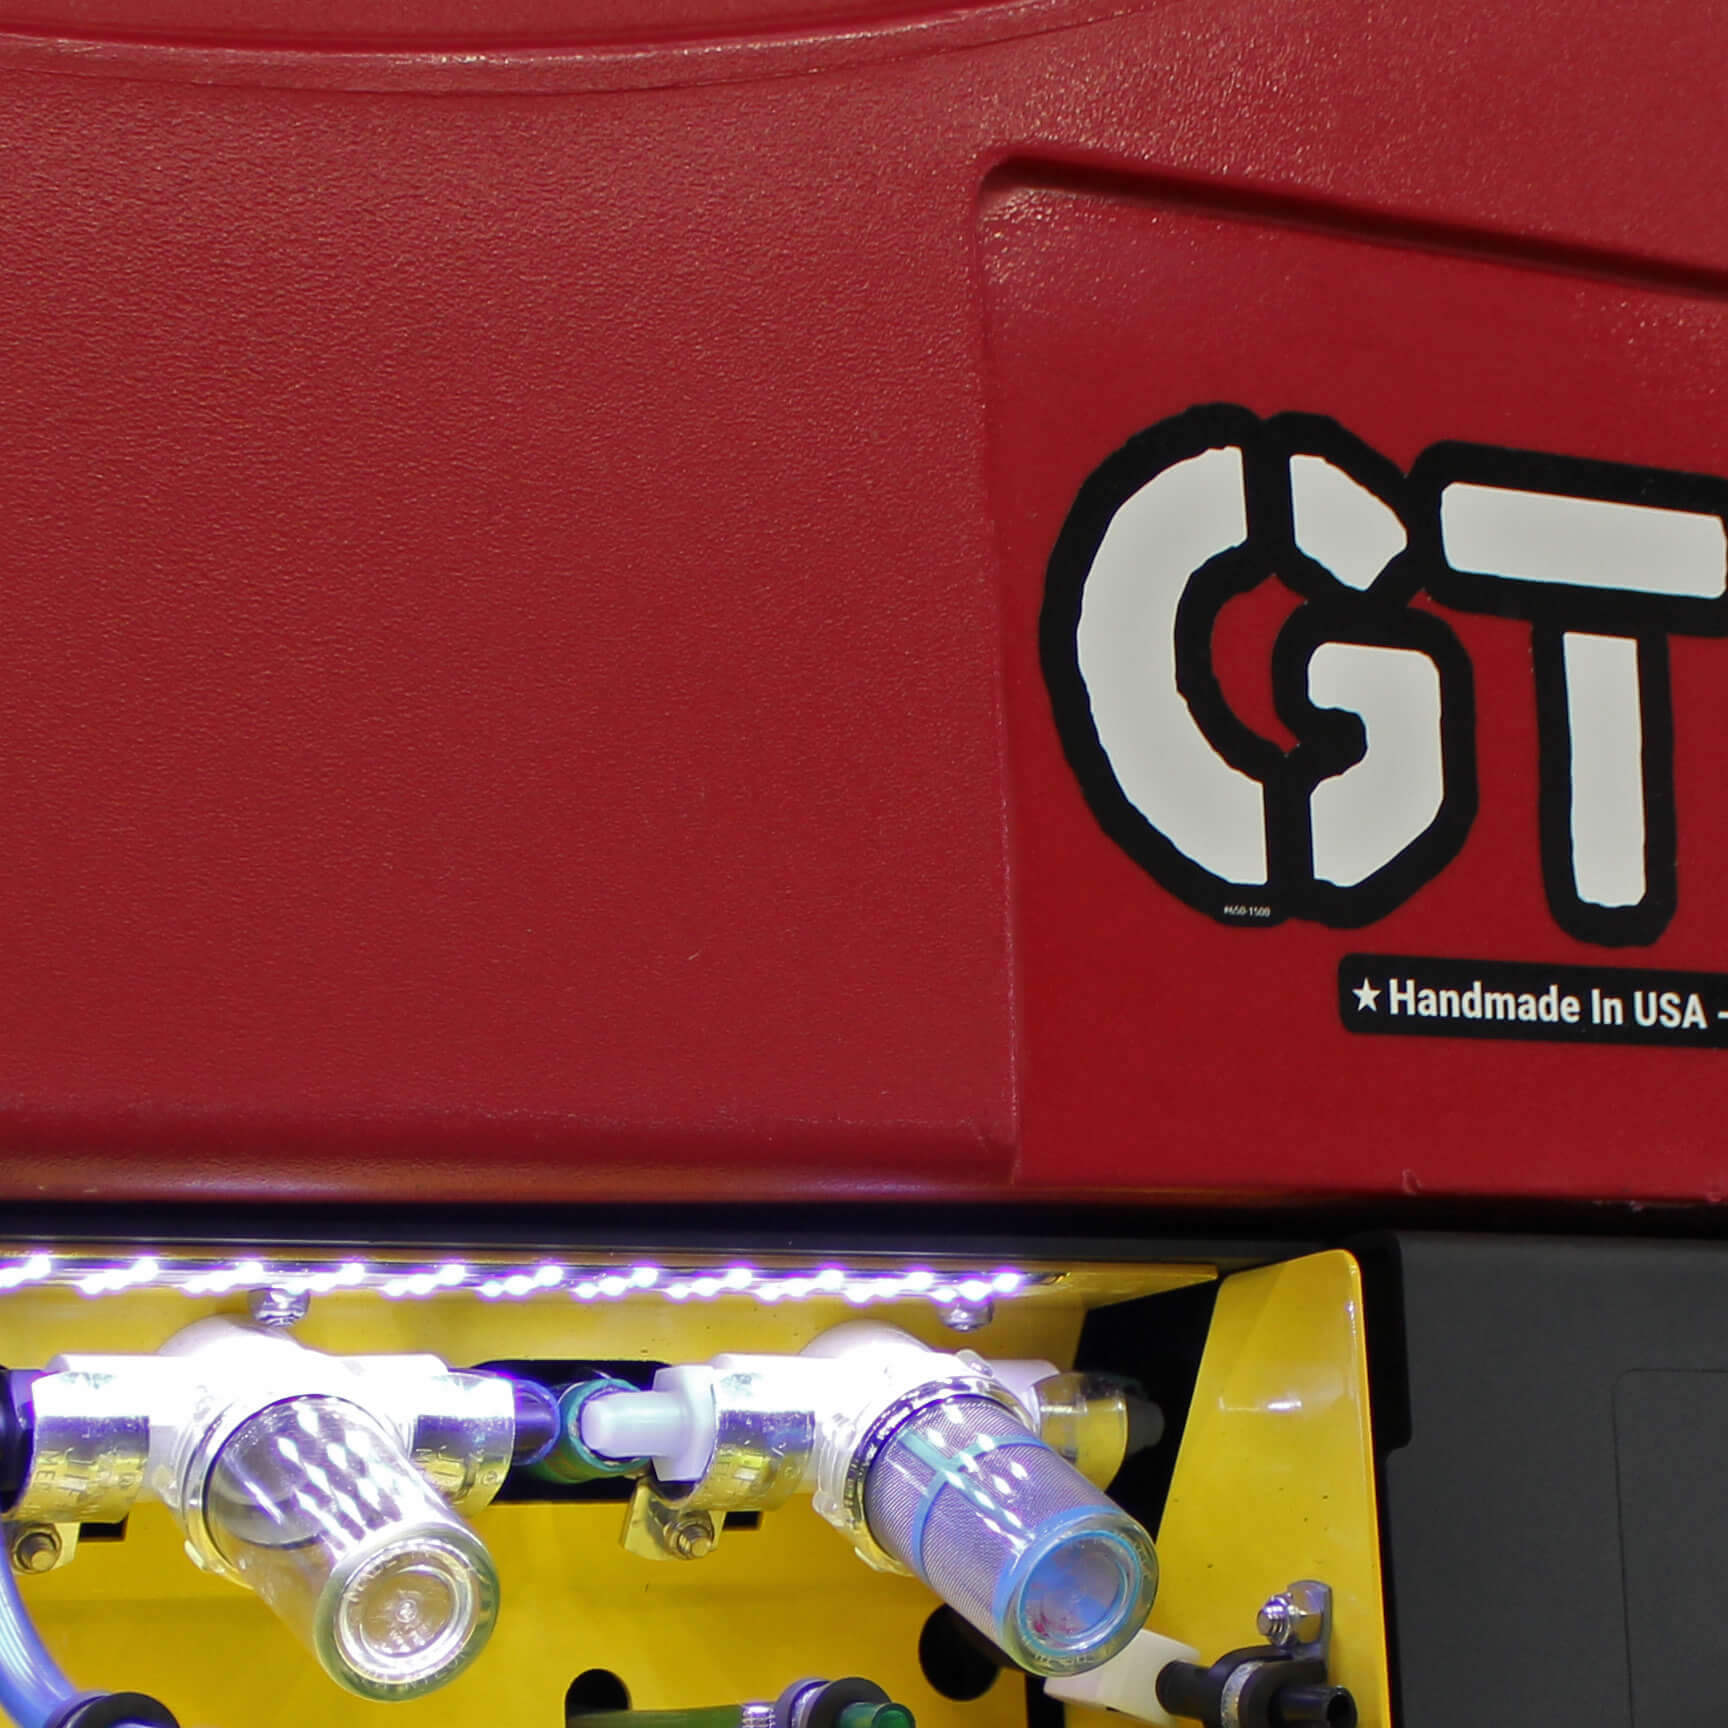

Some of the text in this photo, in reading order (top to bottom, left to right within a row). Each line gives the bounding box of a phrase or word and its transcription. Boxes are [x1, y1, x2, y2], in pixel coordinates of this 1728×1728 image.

[1388, 978, 1581, 1024] Handmade
[1591, 988, 1624, 1025] In
[1633, 991, 1708, 1030] USA
